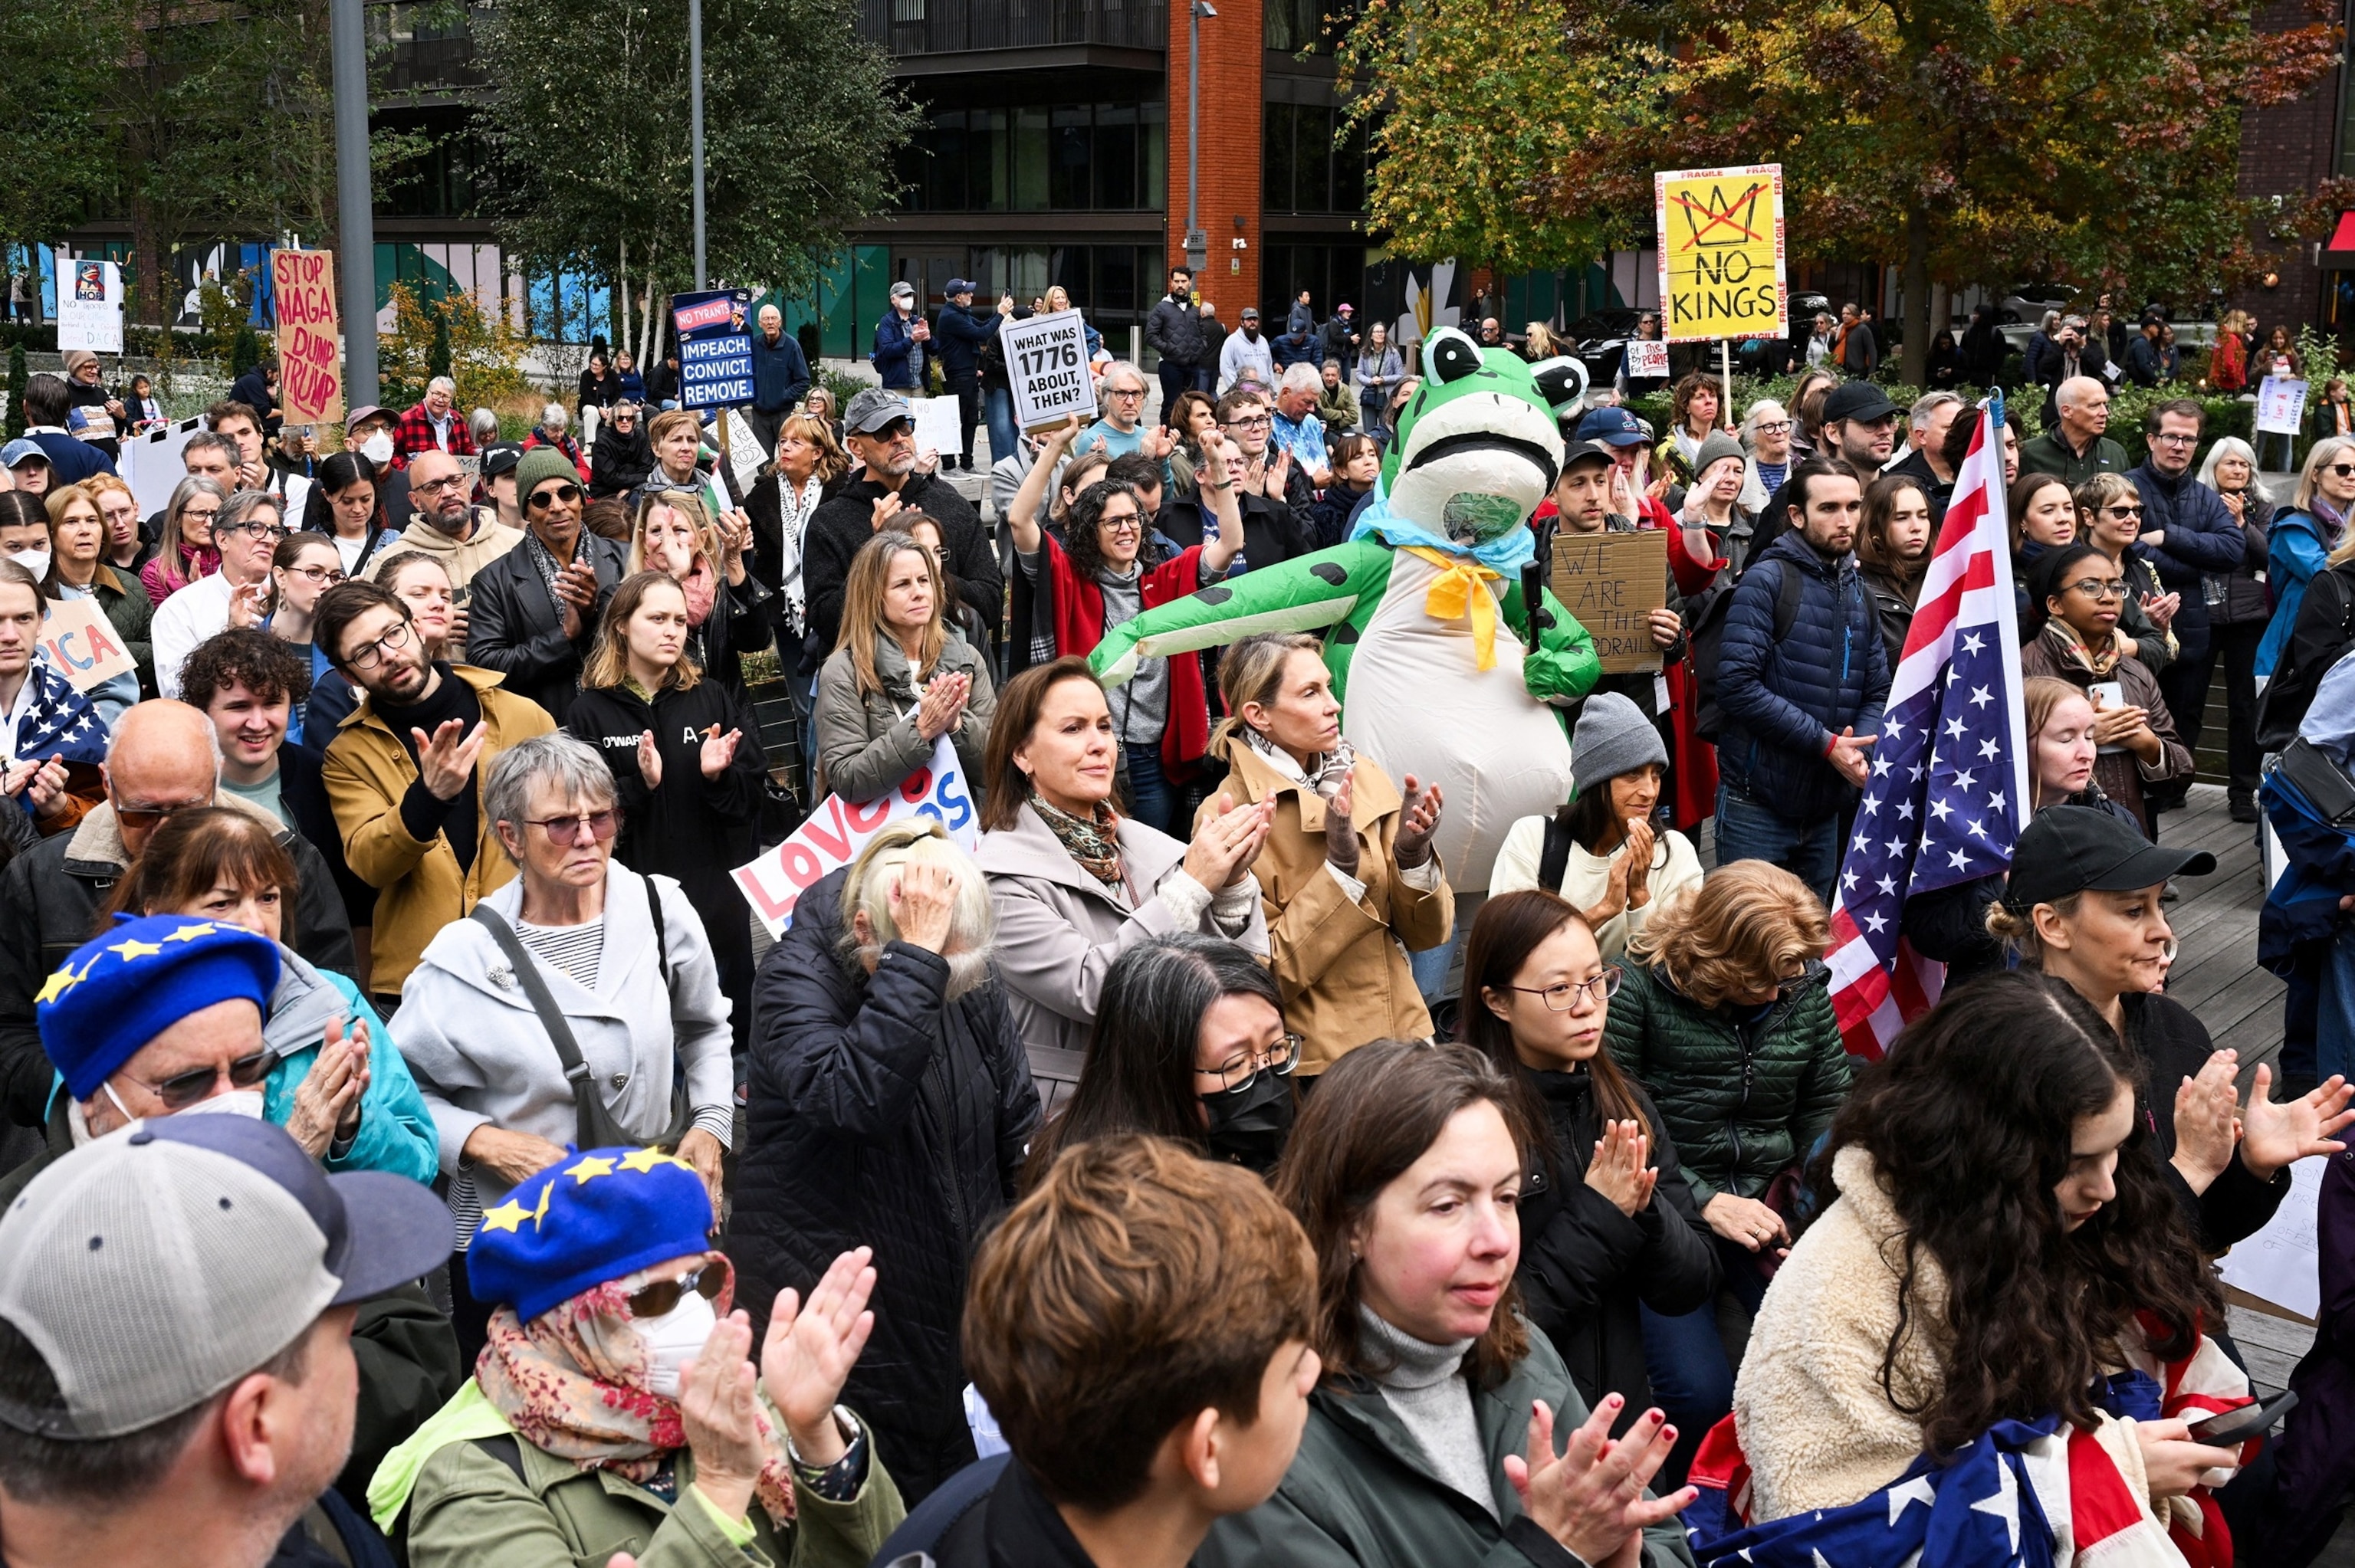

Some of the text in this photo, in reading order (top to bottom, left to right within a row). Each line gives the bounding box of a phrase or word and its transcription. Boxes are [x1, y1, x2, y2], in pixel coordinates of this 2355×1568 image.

[1681, 170, 1723, 179] FRAGILE
[277, 254, 324, 284] STOP
[1696, 250, 1751, 286] NO
[63, 299, 77, 308] NO
[79, 291, 103, 300] HOP
[276, 287, 333, 326] MAGA
[1672, 285, 1776, 324] KINGS
[678, 303, 730, 326] NO TYRANTS
[1660, 295, 1668, 336] FRAGILE
[87, 331, 120, 345] DACA
[1014, 327, 1076, 350] WHAT WAS
[1736, 332, 1779, 340] FRAGILE
[292, 326, 335, 369] DUMP
[682, 337, 751, 359] IMPEACH.
[1644, 343, 1662, 353] The
[684, 359, 751, 380] CONVICT.
[1018, 343, 1078, 376] 1776
[1631, 353, 1668, 366] By PEOPLE
[1631, 365, 1641, 374] For
[283, 350, 337, 415] TRUMP
[684, 379, 752, 403] REMOVE.
[1028, 371, 1081, 394] ABOUT,
[917, 403, 930, 414] NO
[1031, 388, 1080, 410] THEN?
[1560, 543, 1614, 575] WE
[1577, 581, 1626, 609] ARE
[1598, 610, 1647, 631] THE
[34, 624, 120, 678] RICA
[1591, 637, 1660, 658] RDRAILS
[603, 734, 644, 749] O'WAR
[2292, 1164, 2321, 1181] ION
[2292, 1192, 2318, 1209] PRE
